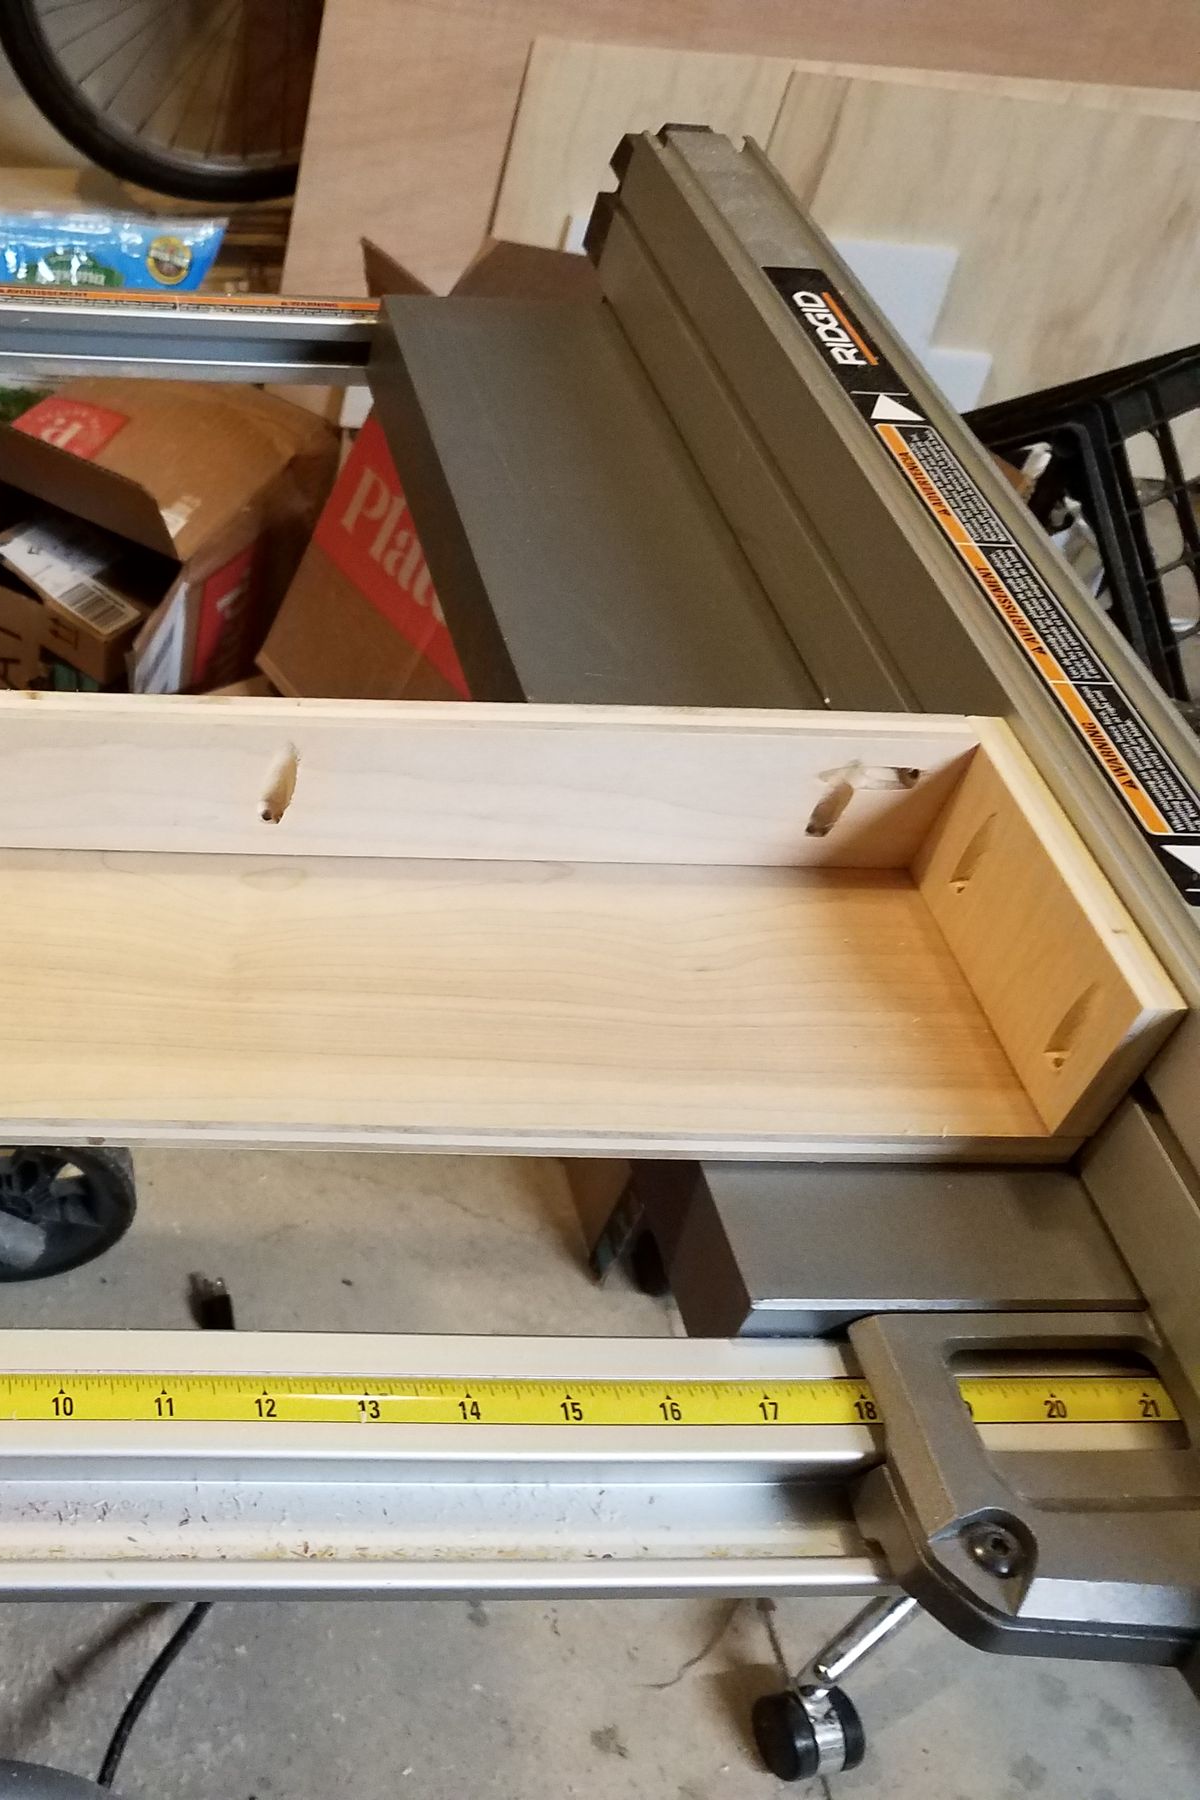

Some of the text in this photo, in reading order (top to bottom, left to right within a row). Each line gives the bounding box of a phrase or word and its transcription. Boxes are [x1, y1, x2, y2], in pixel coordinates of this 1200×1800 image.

[792, 291, 867, 365] RIDGID
[976, 566, 1037, 645] AVERTISSEMENT
[1081, 722, 1128, 777] WARNING
[51, 1396, 74, 1416] 10
[154, 1397, 175, 1416] 11
[255, 1398, 277, 1418] 12
[358, 1400, 380, 1419] 13
[458, 1400, 481, 1420] 14
[560, 1401, 583, 1421] 15
[659, 1402, 682, 1421] 16
[759, 1402, 778, 1420] 17
[854, 1401, 877, 1420] 18
[1043, 1400, 1067, 1419] 20
[1138, 1399, 1161, 1418] 21
